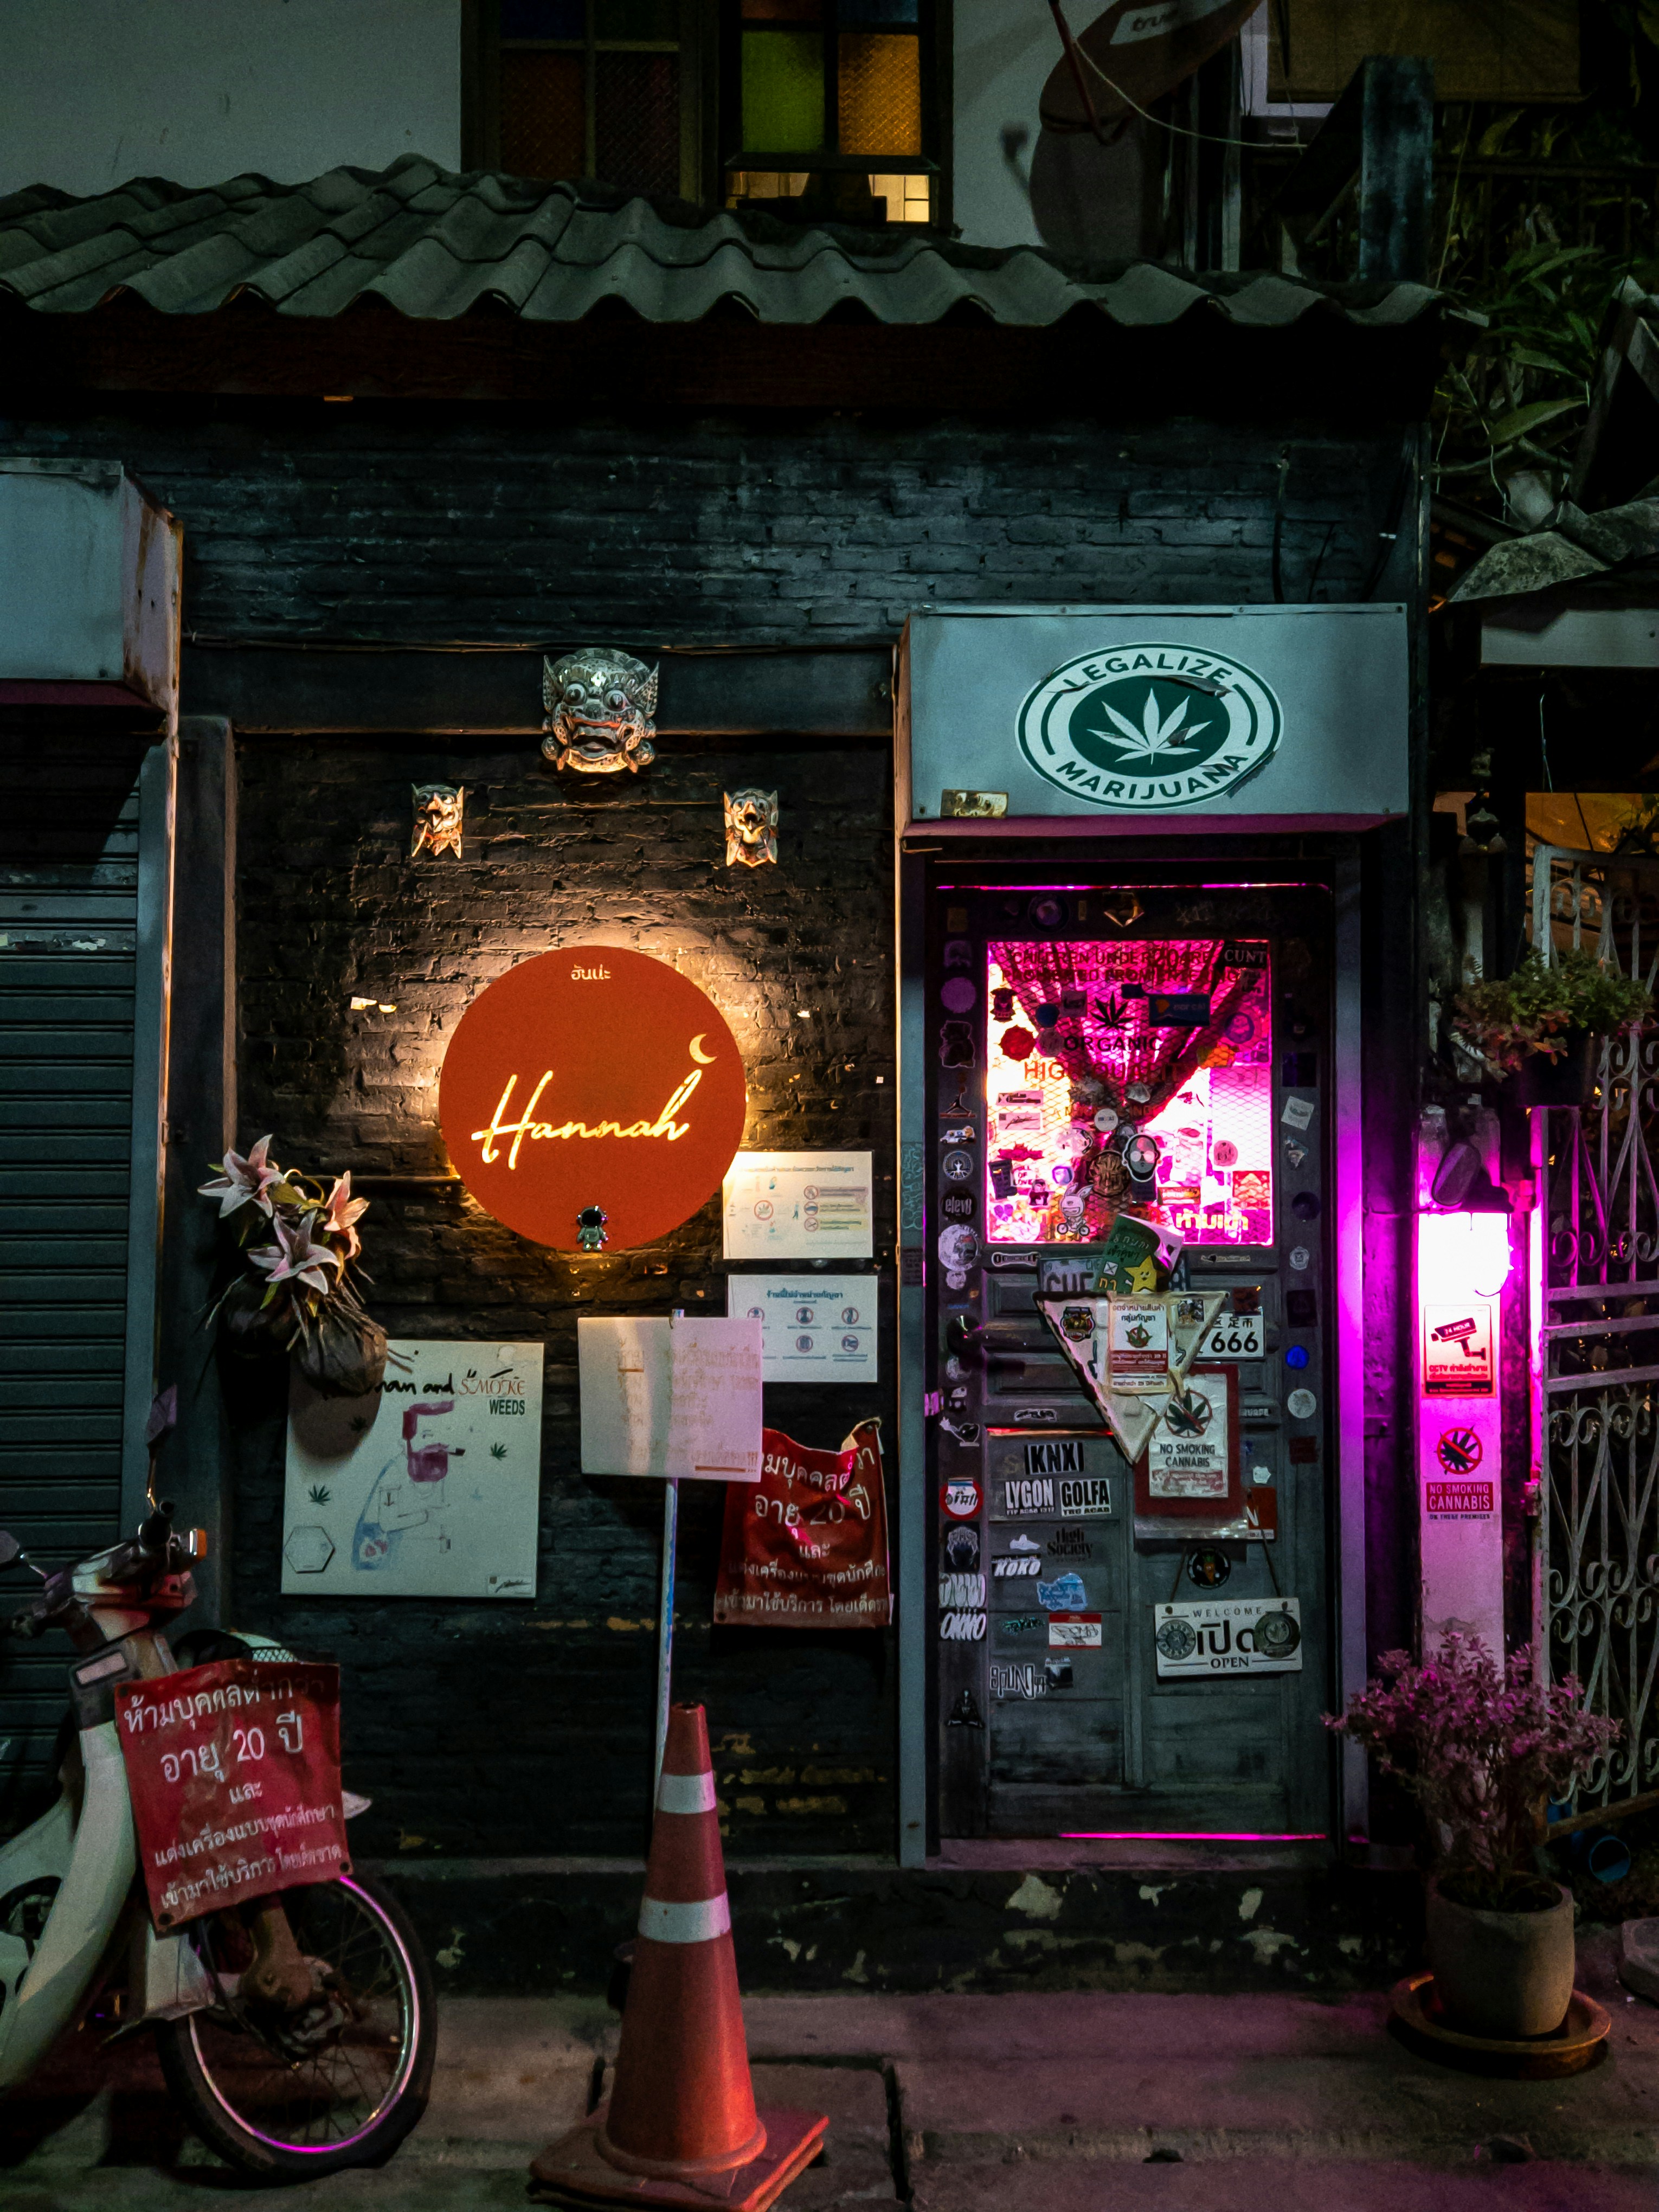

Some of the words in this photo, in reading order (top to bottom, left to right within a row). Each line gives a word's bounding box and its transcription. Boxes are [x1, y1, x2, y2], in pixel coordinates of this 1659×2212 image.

[1064, 653, 1232, 687] LEGALIZE
[1057, 753, 1249, 799] MARIJUANA
[1224, 949, 1266, 963] CUNT
[1064, 1036, 1162, 1051] ORGANIC
[471, 1069, 702, 1170] Hannah
[1211, 1332, 1258, 1353] 666
[423, 1373, 455, 1395] and
[459, 1378, 526, 1396] SMOKE
[489, 1399, 525, 1416] WEEDS
[1160, 1444, 1173, 1454] NO
[1175, 1444, 1216, 1455] SMOKING
[1166, 1457, 1210, 1467] CANNABIS
[1005, 1479, 1055, 1509] LYGON
[1062, 1480, 1109, 1507] GOLFA
[1430, 1484, 1442, 1494] NO
[1446, 1484, 1489, 1494] SMOKING
[1429, 1495, 1490, 1510] CANNABIS
[799, 1543, 831, 1559] และ
[1193, 1606, 1262, 1618] WELCOME
[1210, 1657, 1249, 1669] OPEN
[160, 1742, 225, 1783] อายุ
[233, 1727, 265, 1763] 20
[275, 1709, 304, 1754] ปี
[229, 1780, 262, 1805] และ
